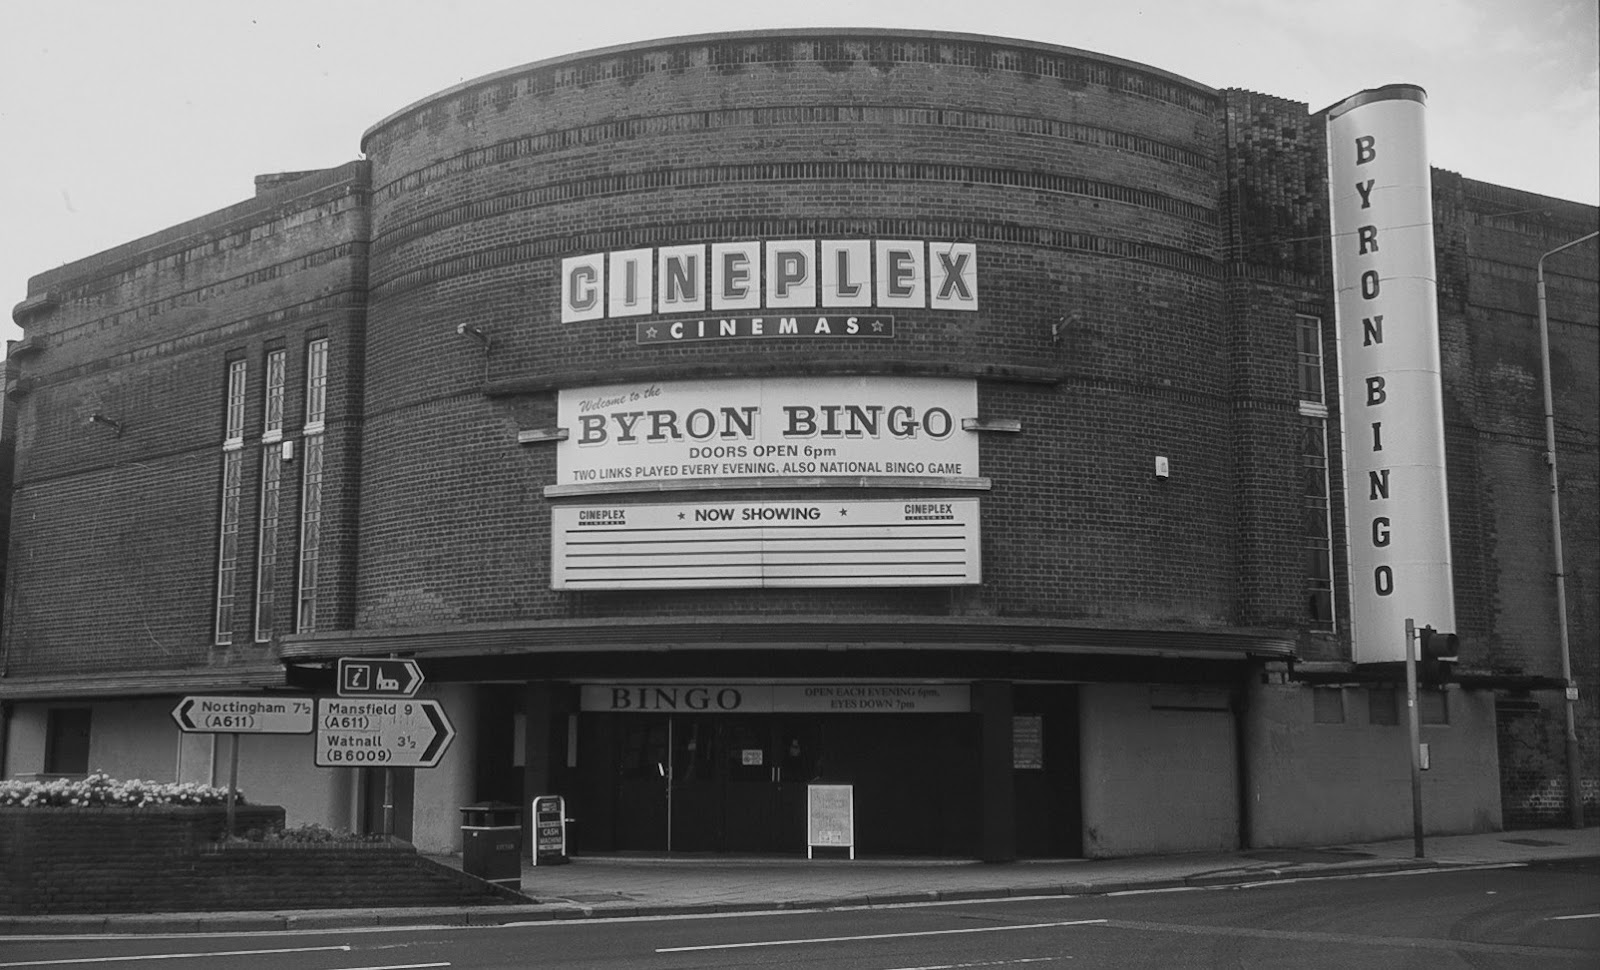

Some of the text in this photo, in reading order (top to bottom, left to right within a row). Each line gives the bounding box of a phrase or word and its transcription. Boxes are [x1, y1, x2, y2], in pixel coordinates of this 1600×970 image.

[568, 249, 974, 312] CINEPLEX
[670, 316, 860, 340] CINEMAS
[1355, 134, 1395, 598] BYRON BINGO
[578, 384, 662, 413] Welcome to the
[577, 404, 955, 446] BYRON BINGO
[689, 444, 837, 460] DOORS OPEN 6pm
[573, 469, 596, 481] TWO
[599, 467, 632, 480] LINKS
[635, 465, 679, 478] PLAYED
[681, 463, 719, 476] EVERY
[783, 461, 816, 474] ALSO
[820, 462, 882, 474] NATIONAL
[886, 462, 925, 474] BINGO
[928, 463, 962, 475] GAME
[579, 509, 626, 520] CINEPLEX
[694, 506, 821, 522] NOW SHOWING
[904, 503, 953, 514] CINEPLEX
[611, 686, 742, 711] BINGO
[804, 687, 833, 697] OPEN
[836, 687, 865, 697] EACH
[867, 687, 916, 697] EVENING
[329, 703, 413, 715] Mansfield 9
[831, 699, 857, 709] EYES
[859, 699, 893, 709] DOWN
[327, 735, 383, 747] Watnall
